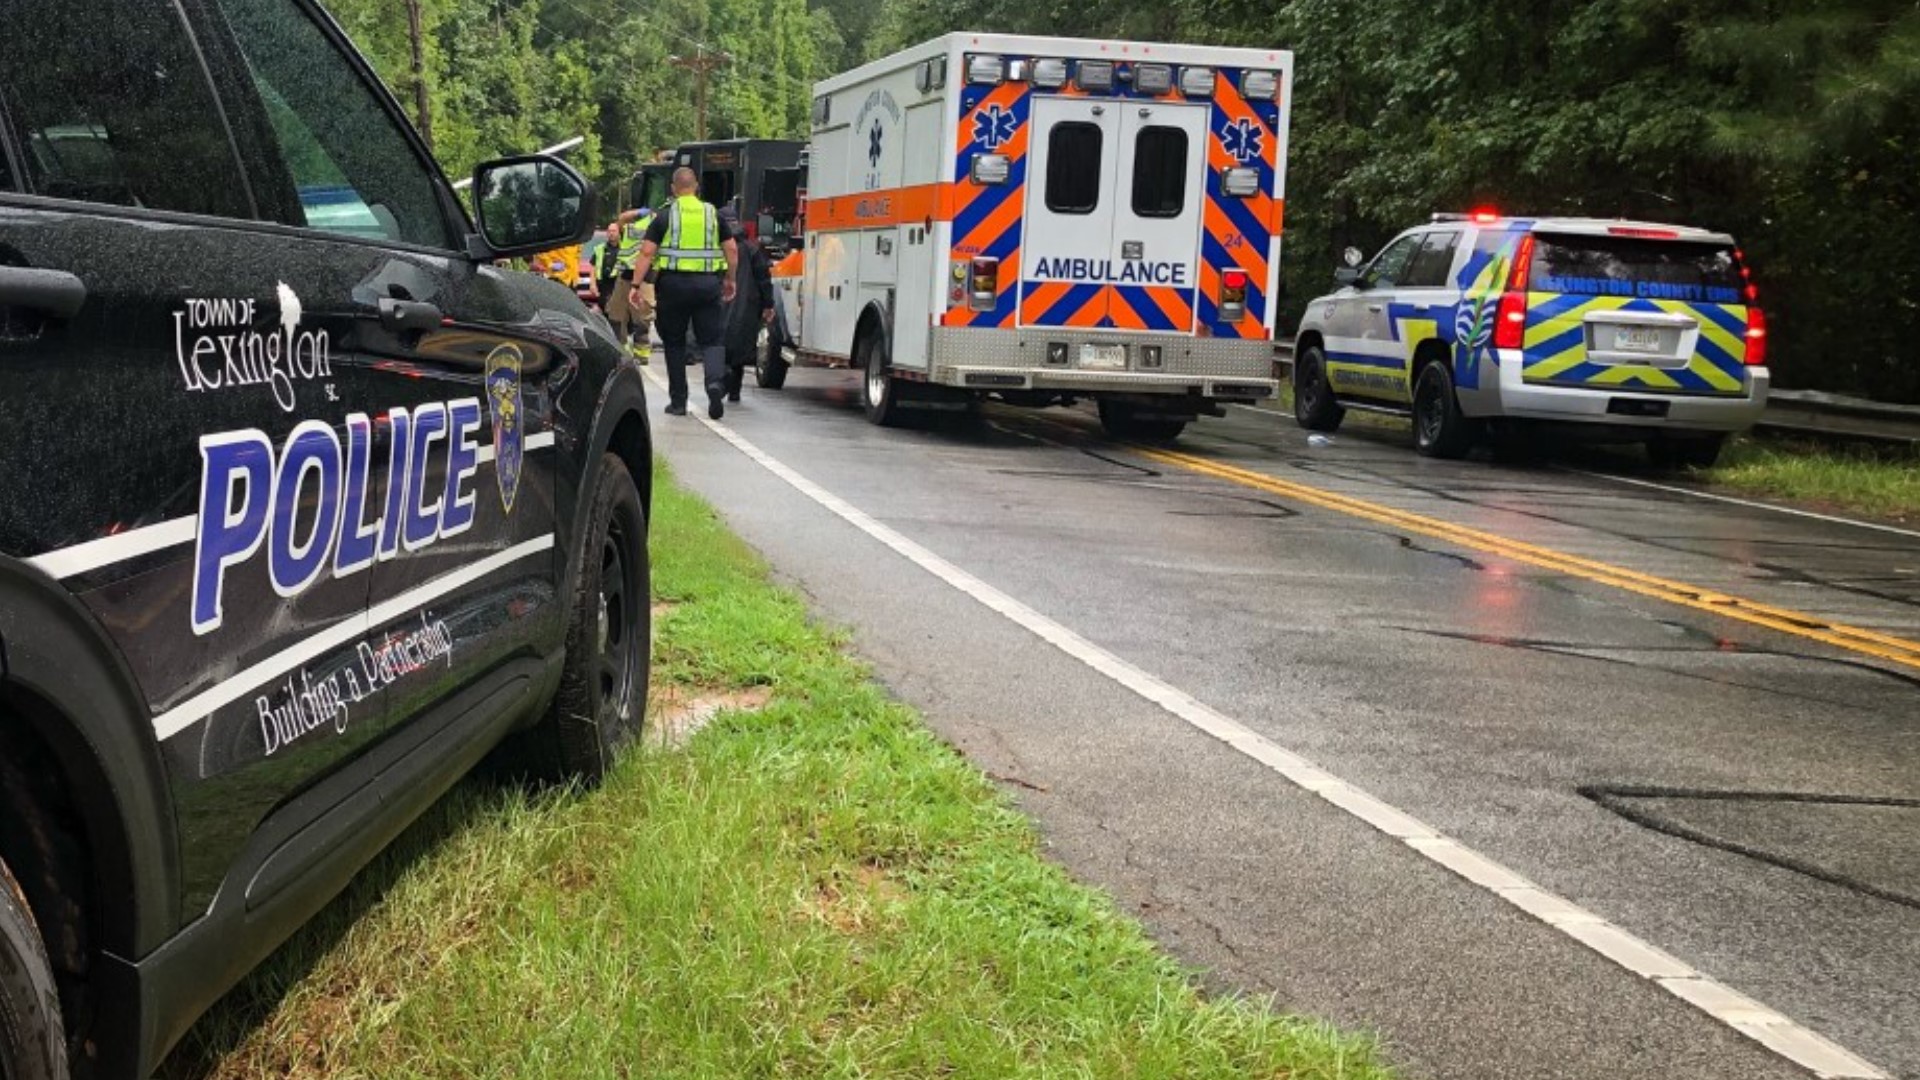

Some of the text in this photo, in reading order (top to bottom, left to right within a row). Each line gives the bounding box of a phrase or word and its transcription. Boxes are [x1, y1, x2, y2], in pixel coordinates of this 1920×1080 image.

[1224, 233, 1242, 248] 24
[1034, 257, 1186, 284] AMBULANCE
[1636, 280, 1702, 299] COUNTY
[185, 298, 237, 328] TOWN
[172, 280, 333, 412] Lexington
[191, 397, 481, 635] POLICE
[256, 667, 349, 756] Building
[356, 609, 453, 691] Partnership
